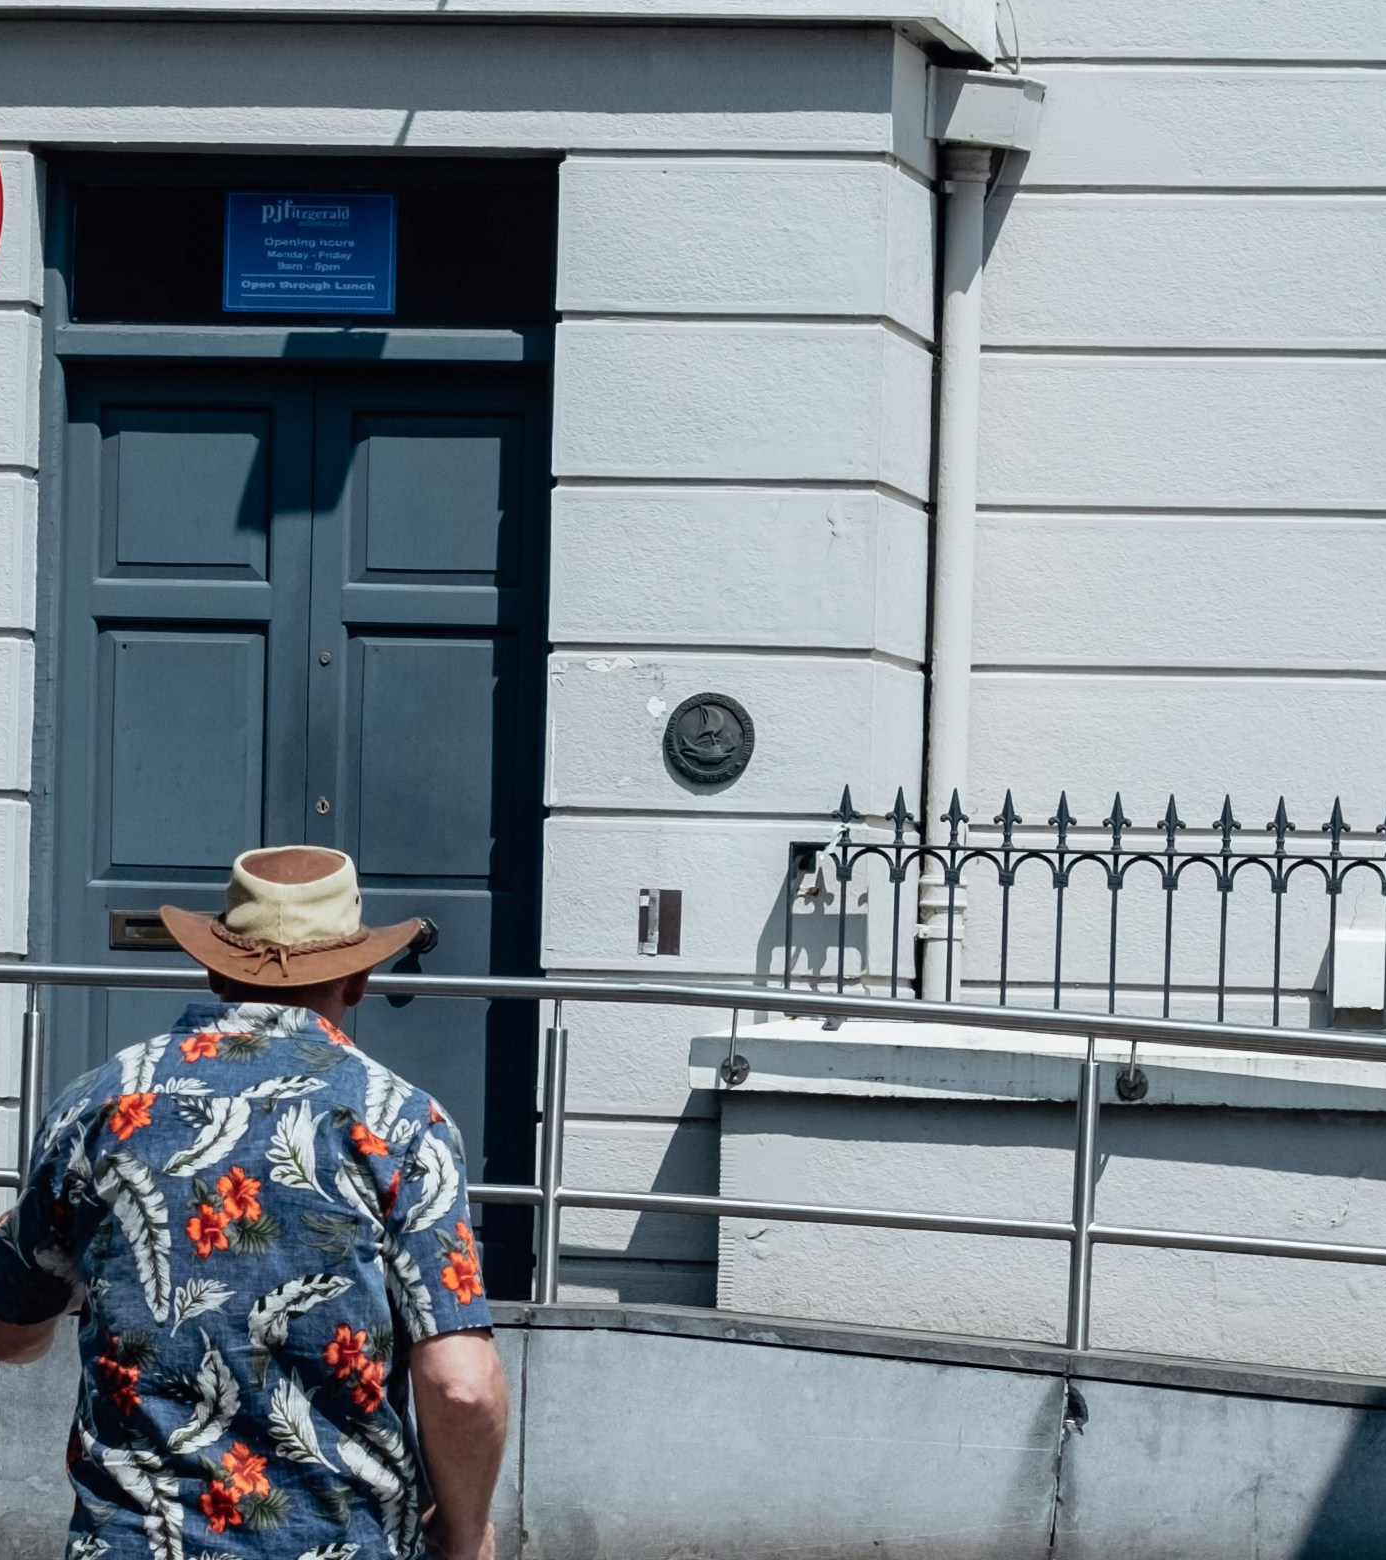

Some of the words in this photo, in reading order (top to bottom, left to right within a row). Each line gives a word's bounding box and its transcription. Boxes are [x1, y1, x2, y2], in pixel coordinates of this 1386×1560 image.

[264, 237, 316, 249] Opening
[241, 280, 275, 290] Open
[279, 281, 331, 292] through
[334, 281, 375, 291] Lunch
